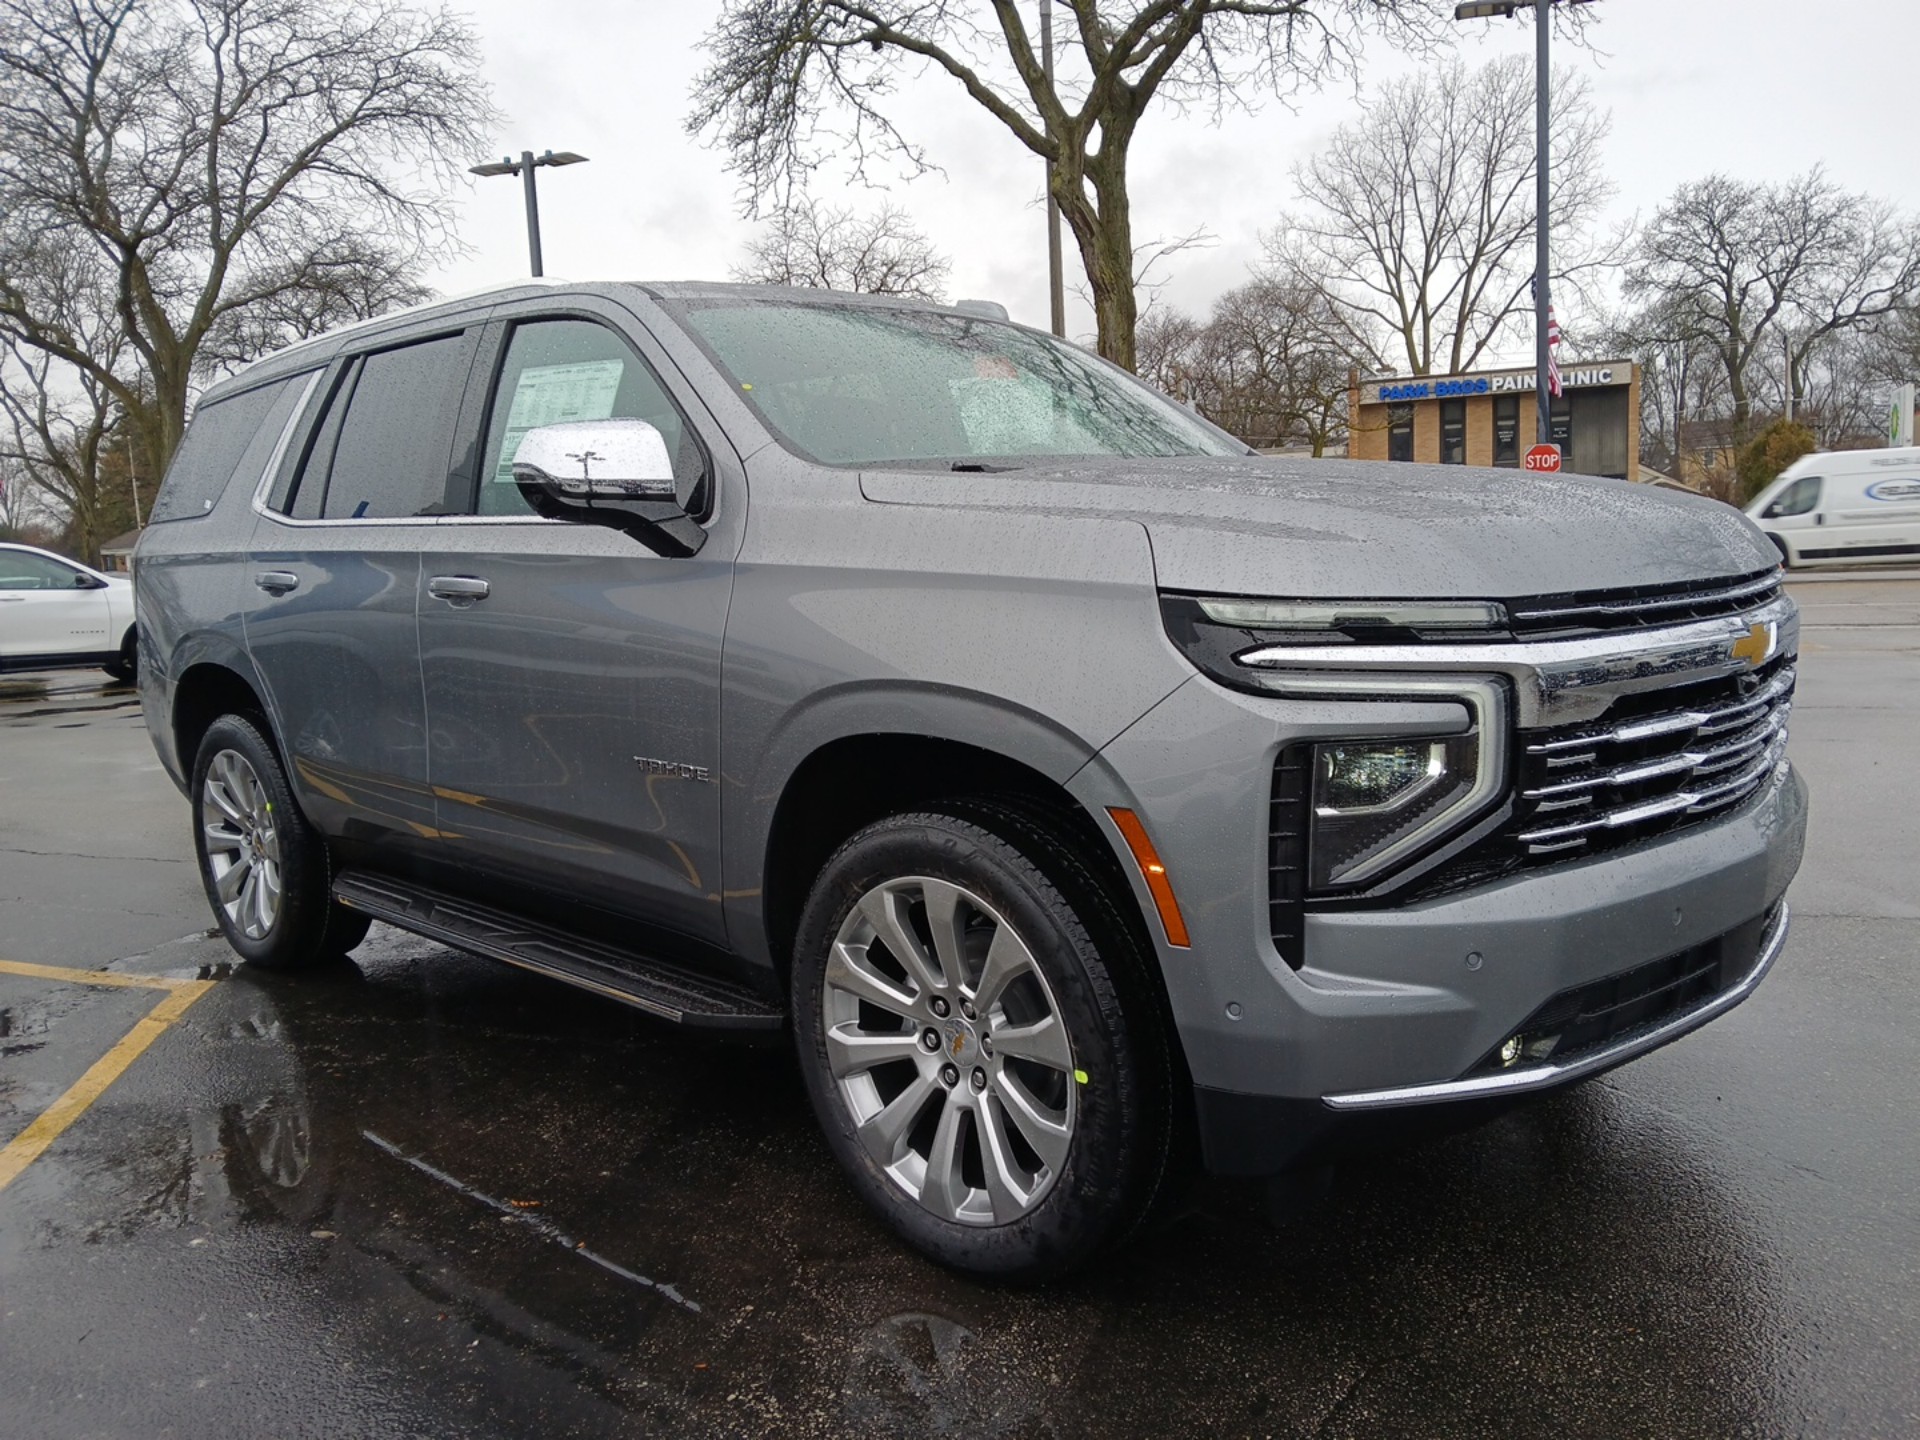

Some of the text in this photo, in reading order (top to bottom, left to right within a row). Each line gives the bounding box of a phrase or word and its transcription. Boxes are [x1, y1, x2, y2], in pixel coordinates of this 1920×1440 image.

[1379, 368, 1612, 400] PARK BROS PAIN LINIC
[1526, 454, 1559, 469] STOP
